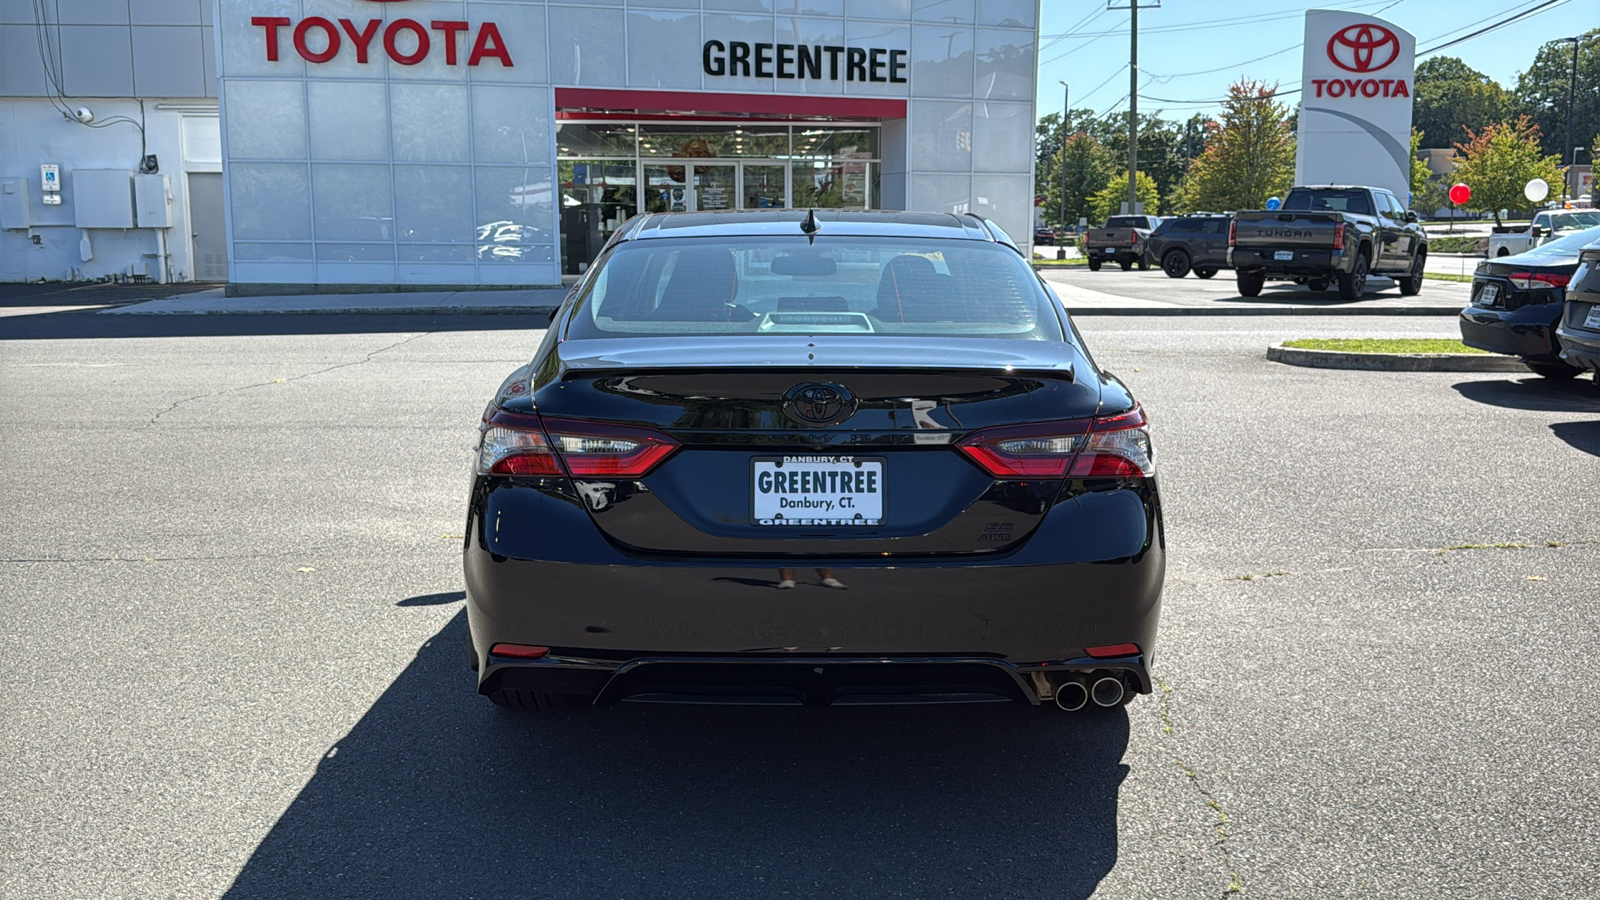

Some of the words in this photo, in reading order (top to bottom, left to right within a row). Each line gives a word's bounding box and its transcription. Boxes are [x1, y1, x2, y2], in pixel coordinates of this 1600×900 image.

[251, 16, 514, 67] TOYOTA
[703, 39, 907, 84] GREENTREE
[1311, 78, 1409, 98] TOYOTA
[1257, 230, 1313, 238] TUNDRA
[783, 456, 837, 464] DANBURY,
[758, 471, 877, 494] GREENTREE
[780, 496, 835, 512] Danbury,
[838, 497, 855, 508] CT.
[759, 518, 879, 526] GREENTREE
